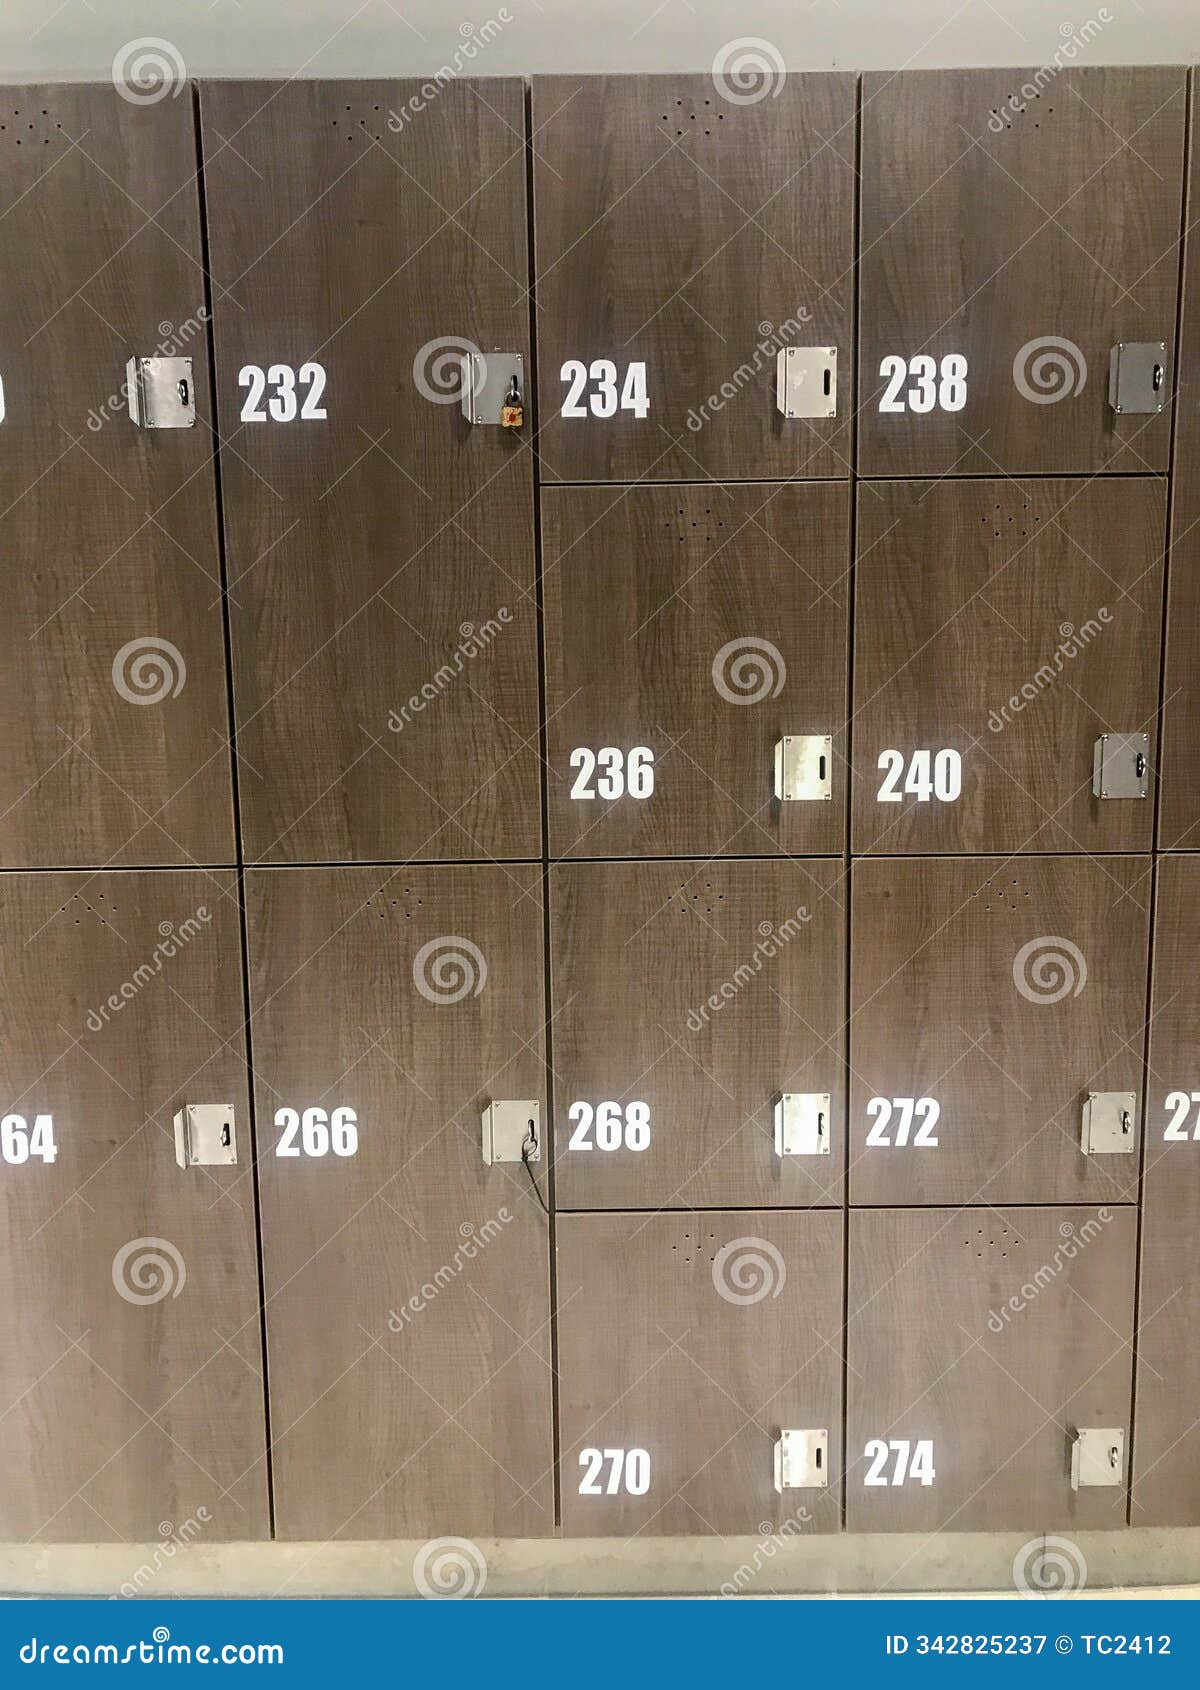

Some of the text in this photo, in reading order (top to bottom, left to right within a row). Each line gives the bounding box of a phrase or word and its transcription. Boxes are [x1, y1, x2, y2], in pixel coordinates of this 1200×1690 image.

[239, 363, 326, 421] 232
[561, 360, 649, 418] 234
[879, 355, 967, 412] 238
[570, 747, 654, 799] 236
[877, 749, 961, 801] 240
[0, 1114, 58, 1164] 64
[275, 1107, 358, 1156] 266
[569, 1101, 650, 1151] 268
[866, 1097, 940, 1146] 272
[579, 1448, 650, 1495] 270
[864, 1440, 935, 1486] 274
